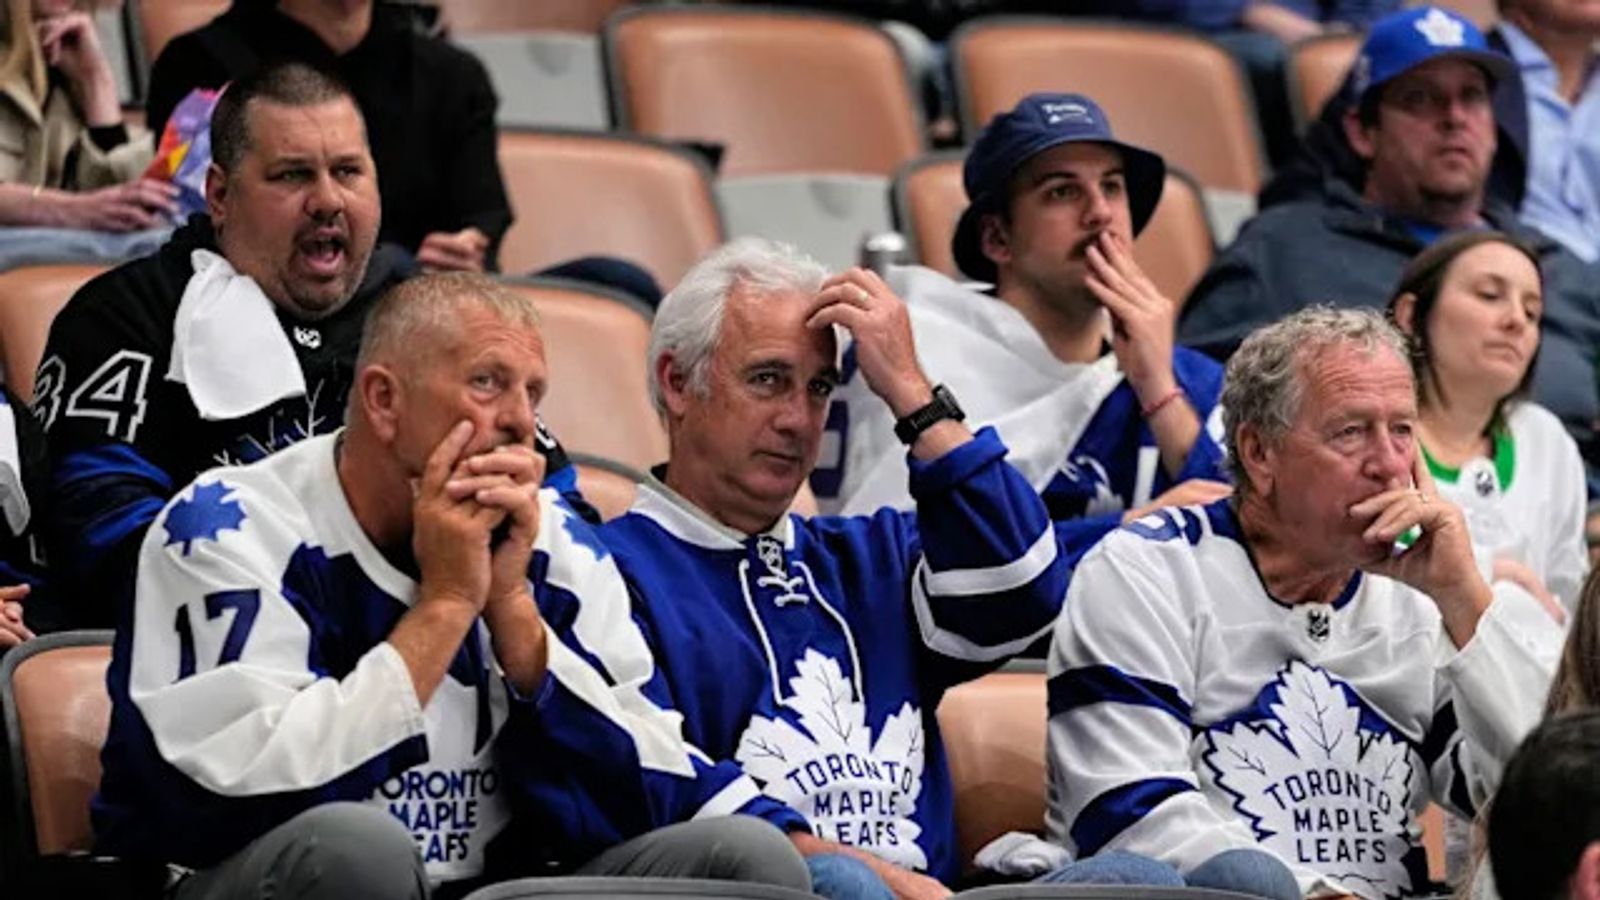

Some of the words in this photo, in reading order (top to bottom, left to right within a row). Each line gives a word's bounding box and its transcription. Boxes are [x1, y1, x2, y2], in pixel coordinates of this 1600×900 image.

[172, 588, 262, 682] 17
[379, 767, 498, 800] ORONTO
[785, 752, 913, 796] TORONTO
[813, 790, 900, 818] MAPLE
[1263, 768, 1391, 816] TORONTO
[1293, 808, 1384, 833] MAPLE
[1296, 837, 1387, 863] LEAFS
